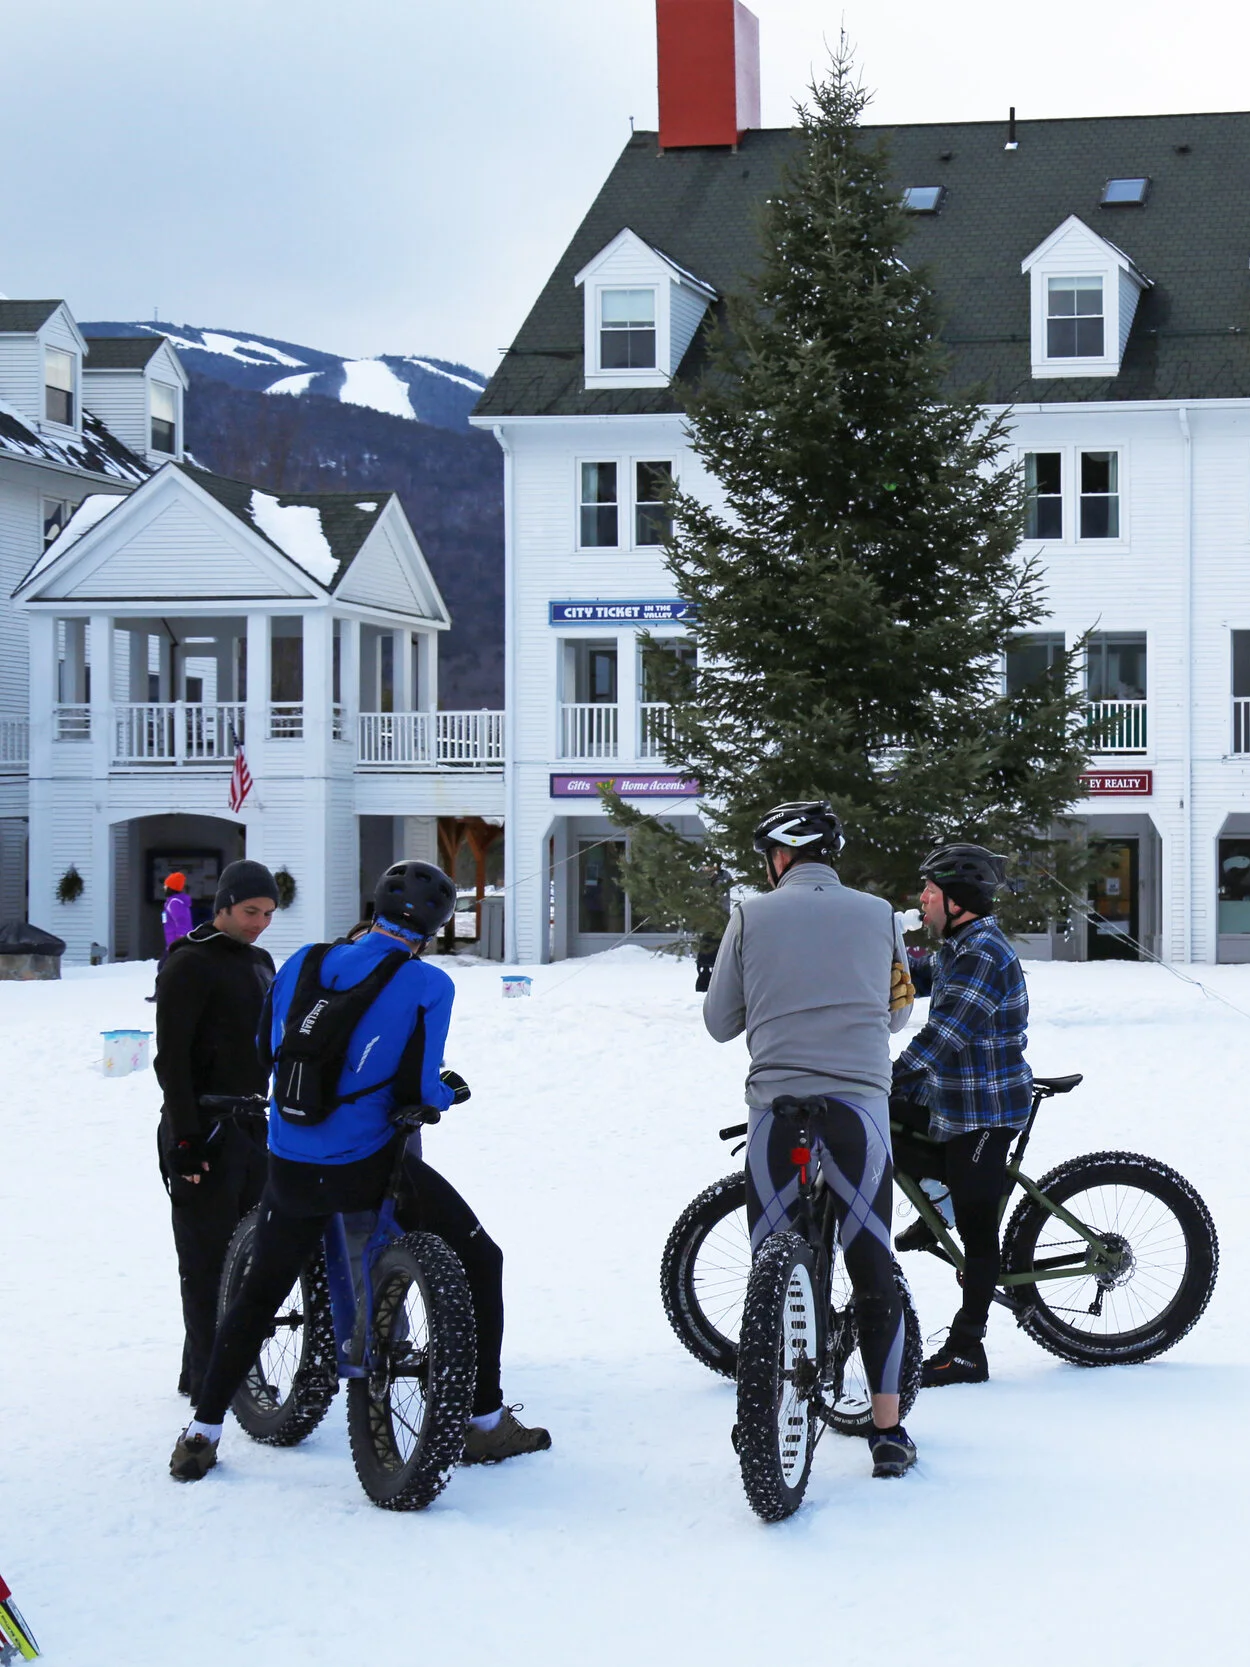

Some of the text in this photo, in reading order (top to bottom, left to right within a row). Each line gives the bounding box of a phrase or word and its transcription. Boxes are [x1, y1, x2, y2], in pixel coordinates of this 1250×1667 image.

[563, 606, 641, 618] CITY TICKET
[567, 780, 686, 791] Gifts Home Accents
[1104, 779, 1141, 788] REALTY
[972, 1131, 990, 1163] CAPO
